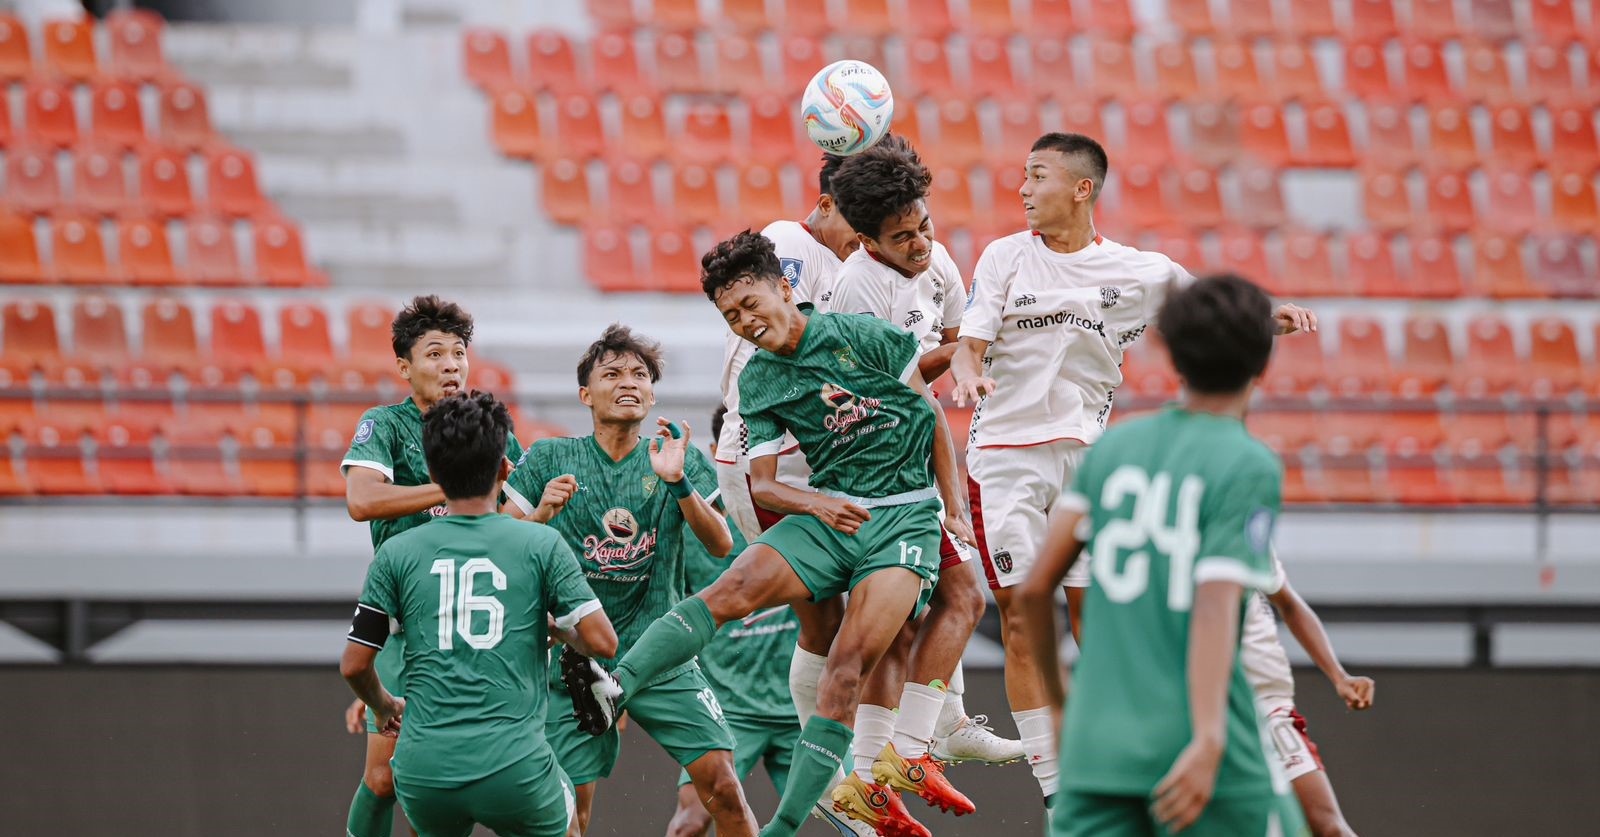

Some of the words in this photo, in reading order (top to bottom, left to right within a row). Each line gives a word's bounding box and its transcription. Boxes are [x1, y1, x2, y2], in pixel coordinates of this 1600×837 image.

[817, 136, 847, 147] SPECS
[1014, 298, 1037, 308] SPECS
[904, 314, 924, 329] SPECS
[584, 535, 632, 566] Kapal
[1092, 464, 1204, 611] 24
[898, 540, 923, 567] 17
[429, 557, 507, 650] 16
[696, 687, 723, 720] 12
